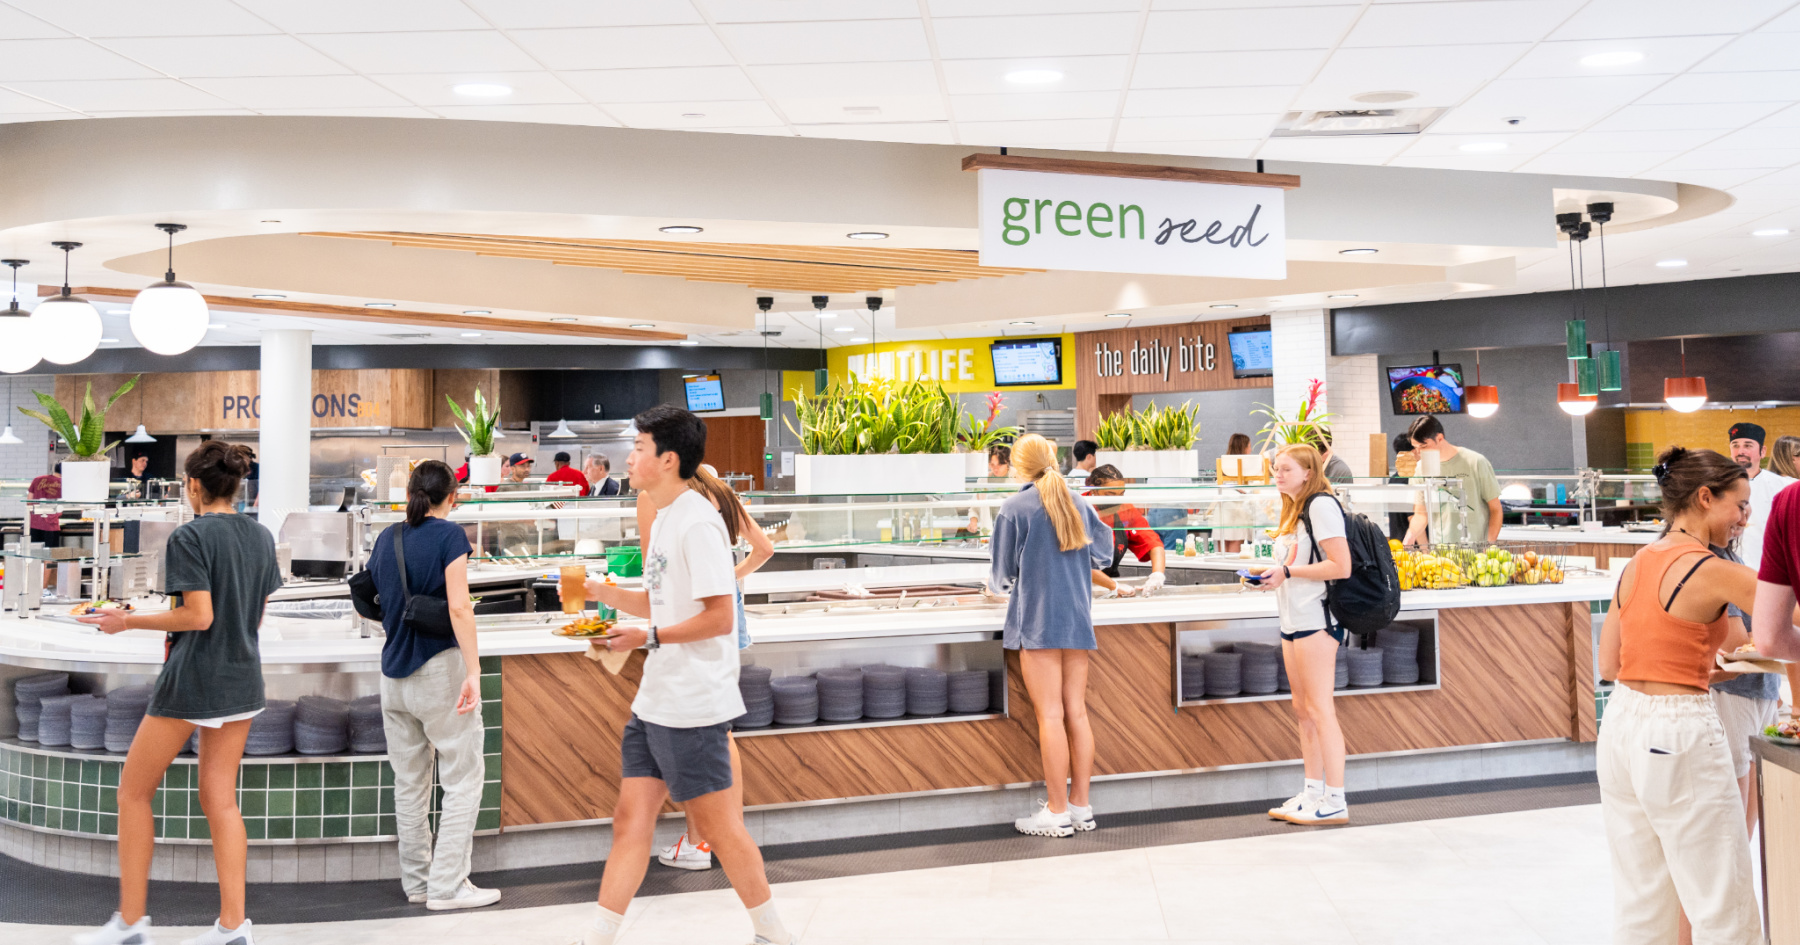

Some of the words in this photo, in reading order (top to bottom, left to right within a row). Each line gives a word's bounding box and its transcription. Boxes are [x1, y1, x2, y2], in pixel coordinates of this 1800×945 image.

[1001, 197, 1145, 246] green
[1154, 203, 1270, 248] seed
[1095, 342, 1123, 377] the
[1130, 338, 1171, 382] daily
[1179, 335, 1216, 373] bite
[223, 393, 361, 419] PROONS
